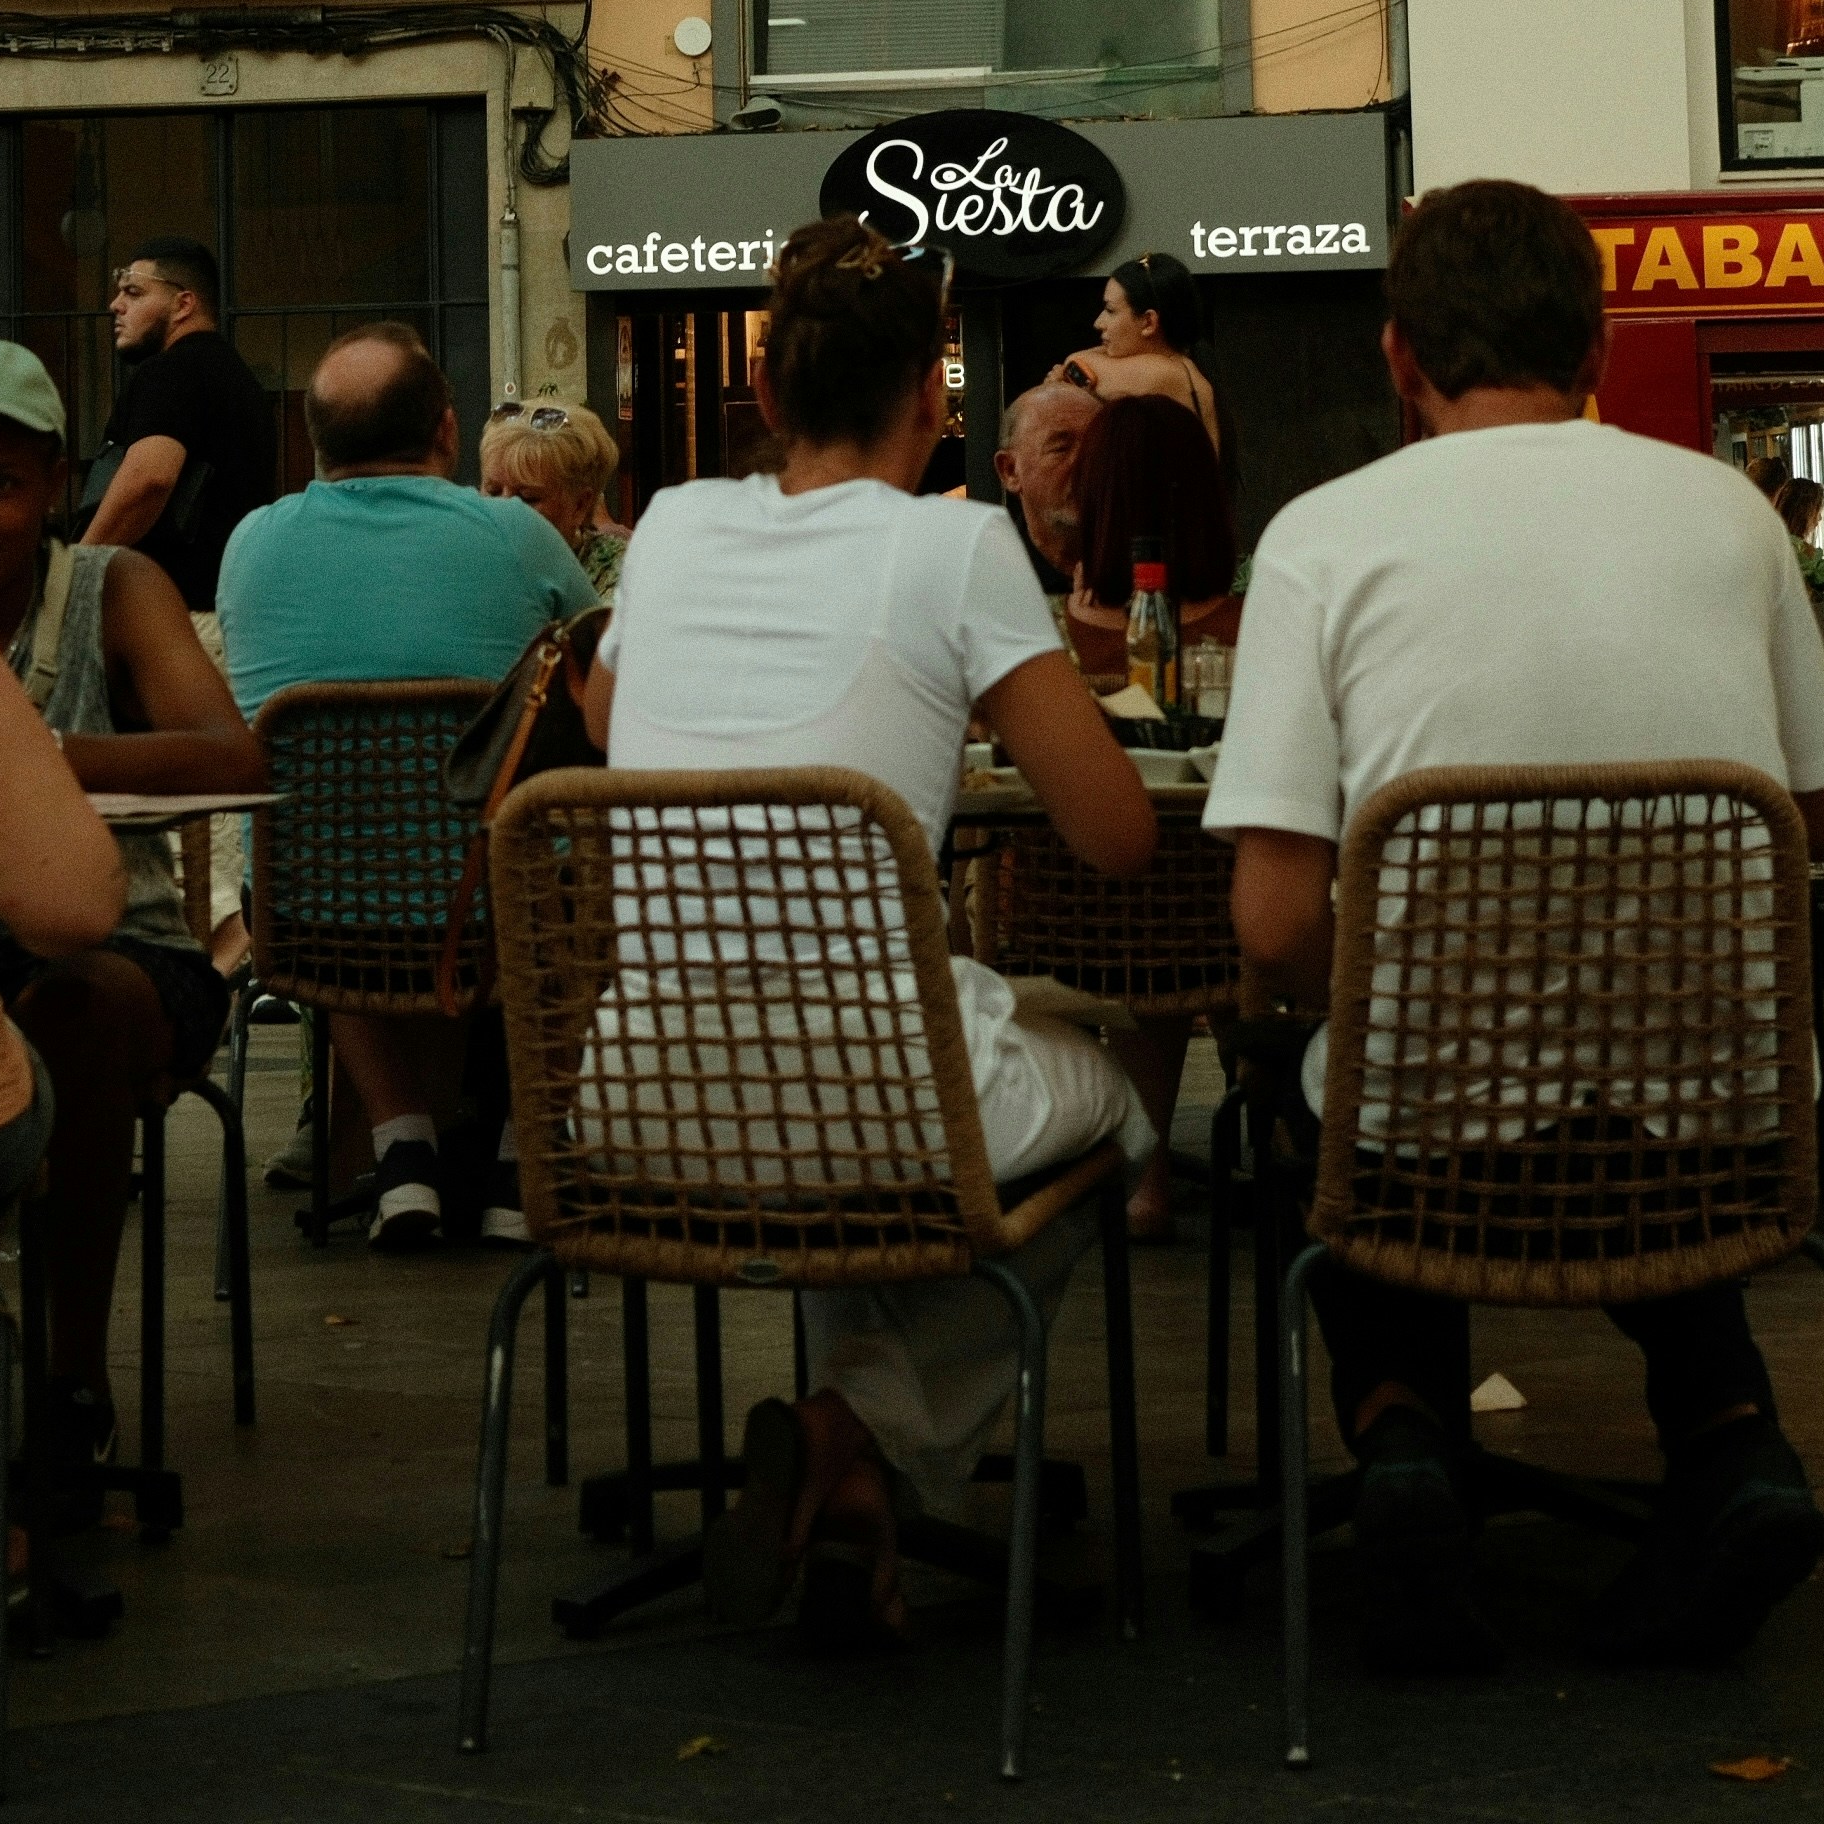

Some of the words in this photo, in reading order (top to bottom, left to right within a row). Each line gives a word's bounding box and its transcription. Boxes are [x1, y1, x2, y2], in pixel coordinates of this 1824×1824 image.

[206, 64, 229, 84] 22
[933, 136, 1021, 190] La
[858, 138, 1104, 246] Siesta
[586, 228, 789, 276] cafeteri
[1190, 219, 1370, 258] terraza
